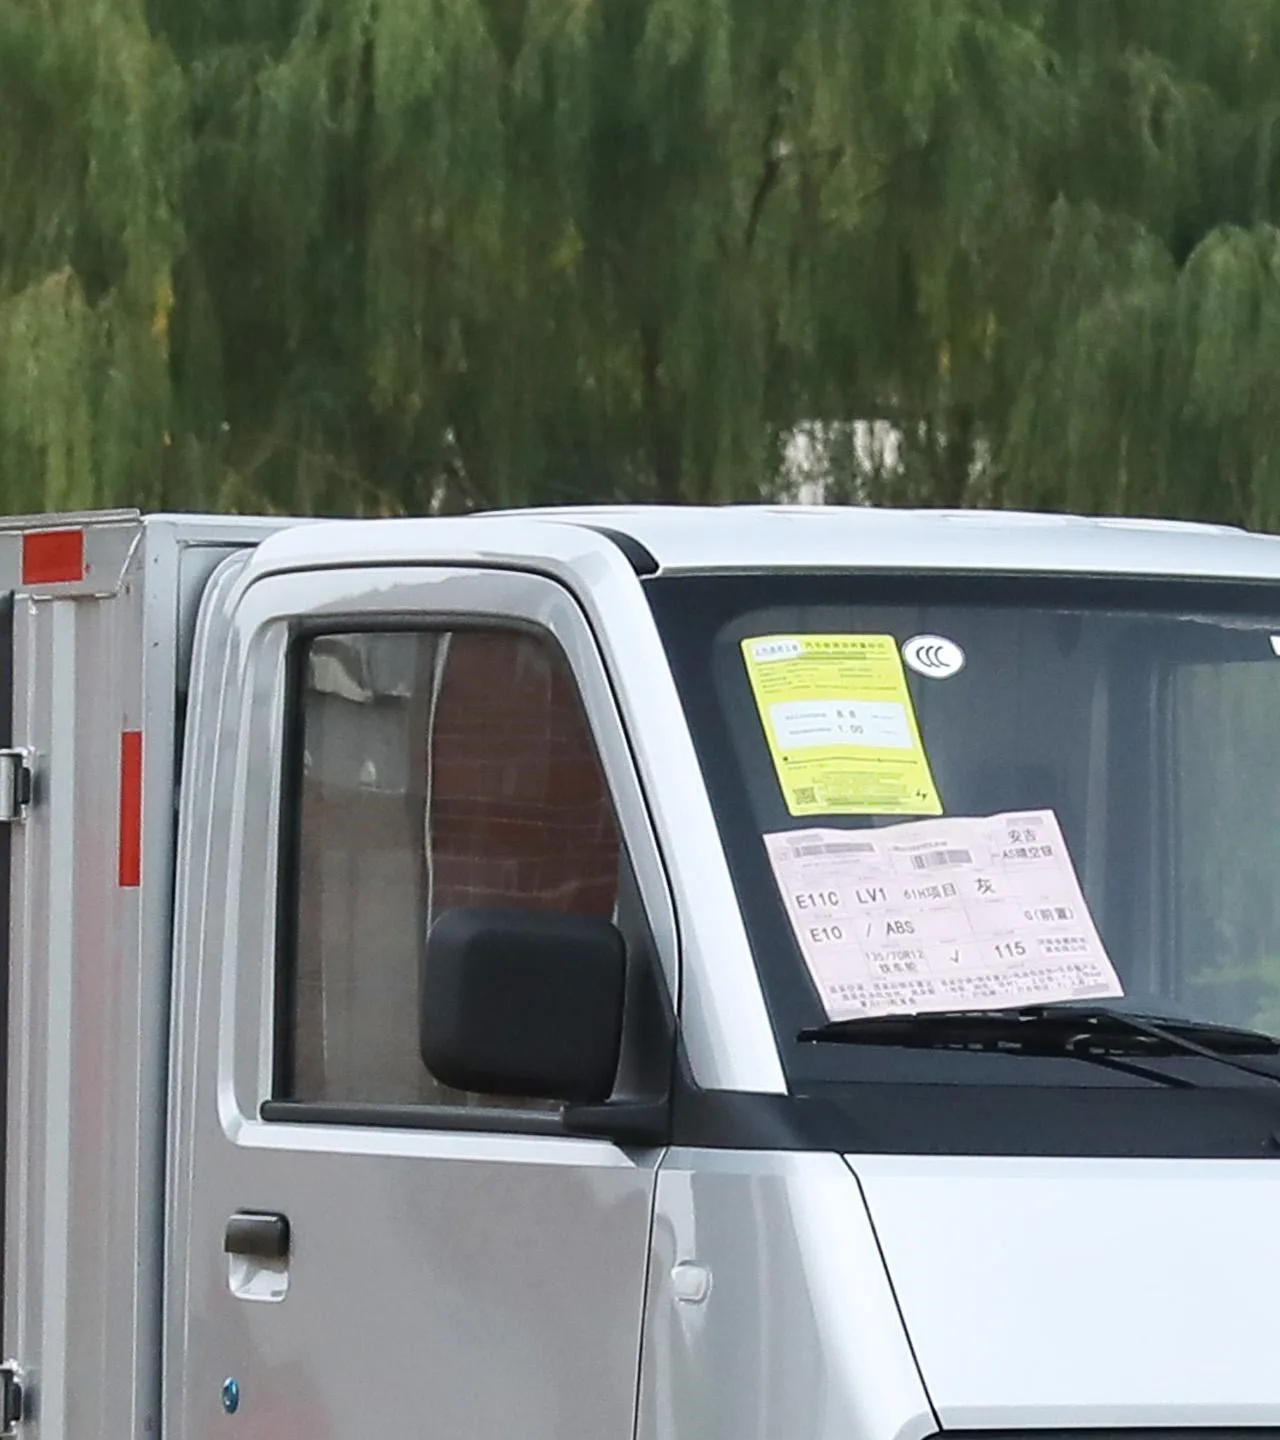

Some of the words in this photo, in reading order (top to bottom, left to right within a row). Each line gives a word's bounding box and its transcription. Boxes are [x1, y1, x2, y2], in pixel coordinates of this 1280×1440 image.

[795, 891, 840, 910] E11C
[855, 887, 888, 904] LV1
[809, 925, 843, 943] E10
[885, 920, 916, 936] ABS
[994, 941, 1027, 960] 115
